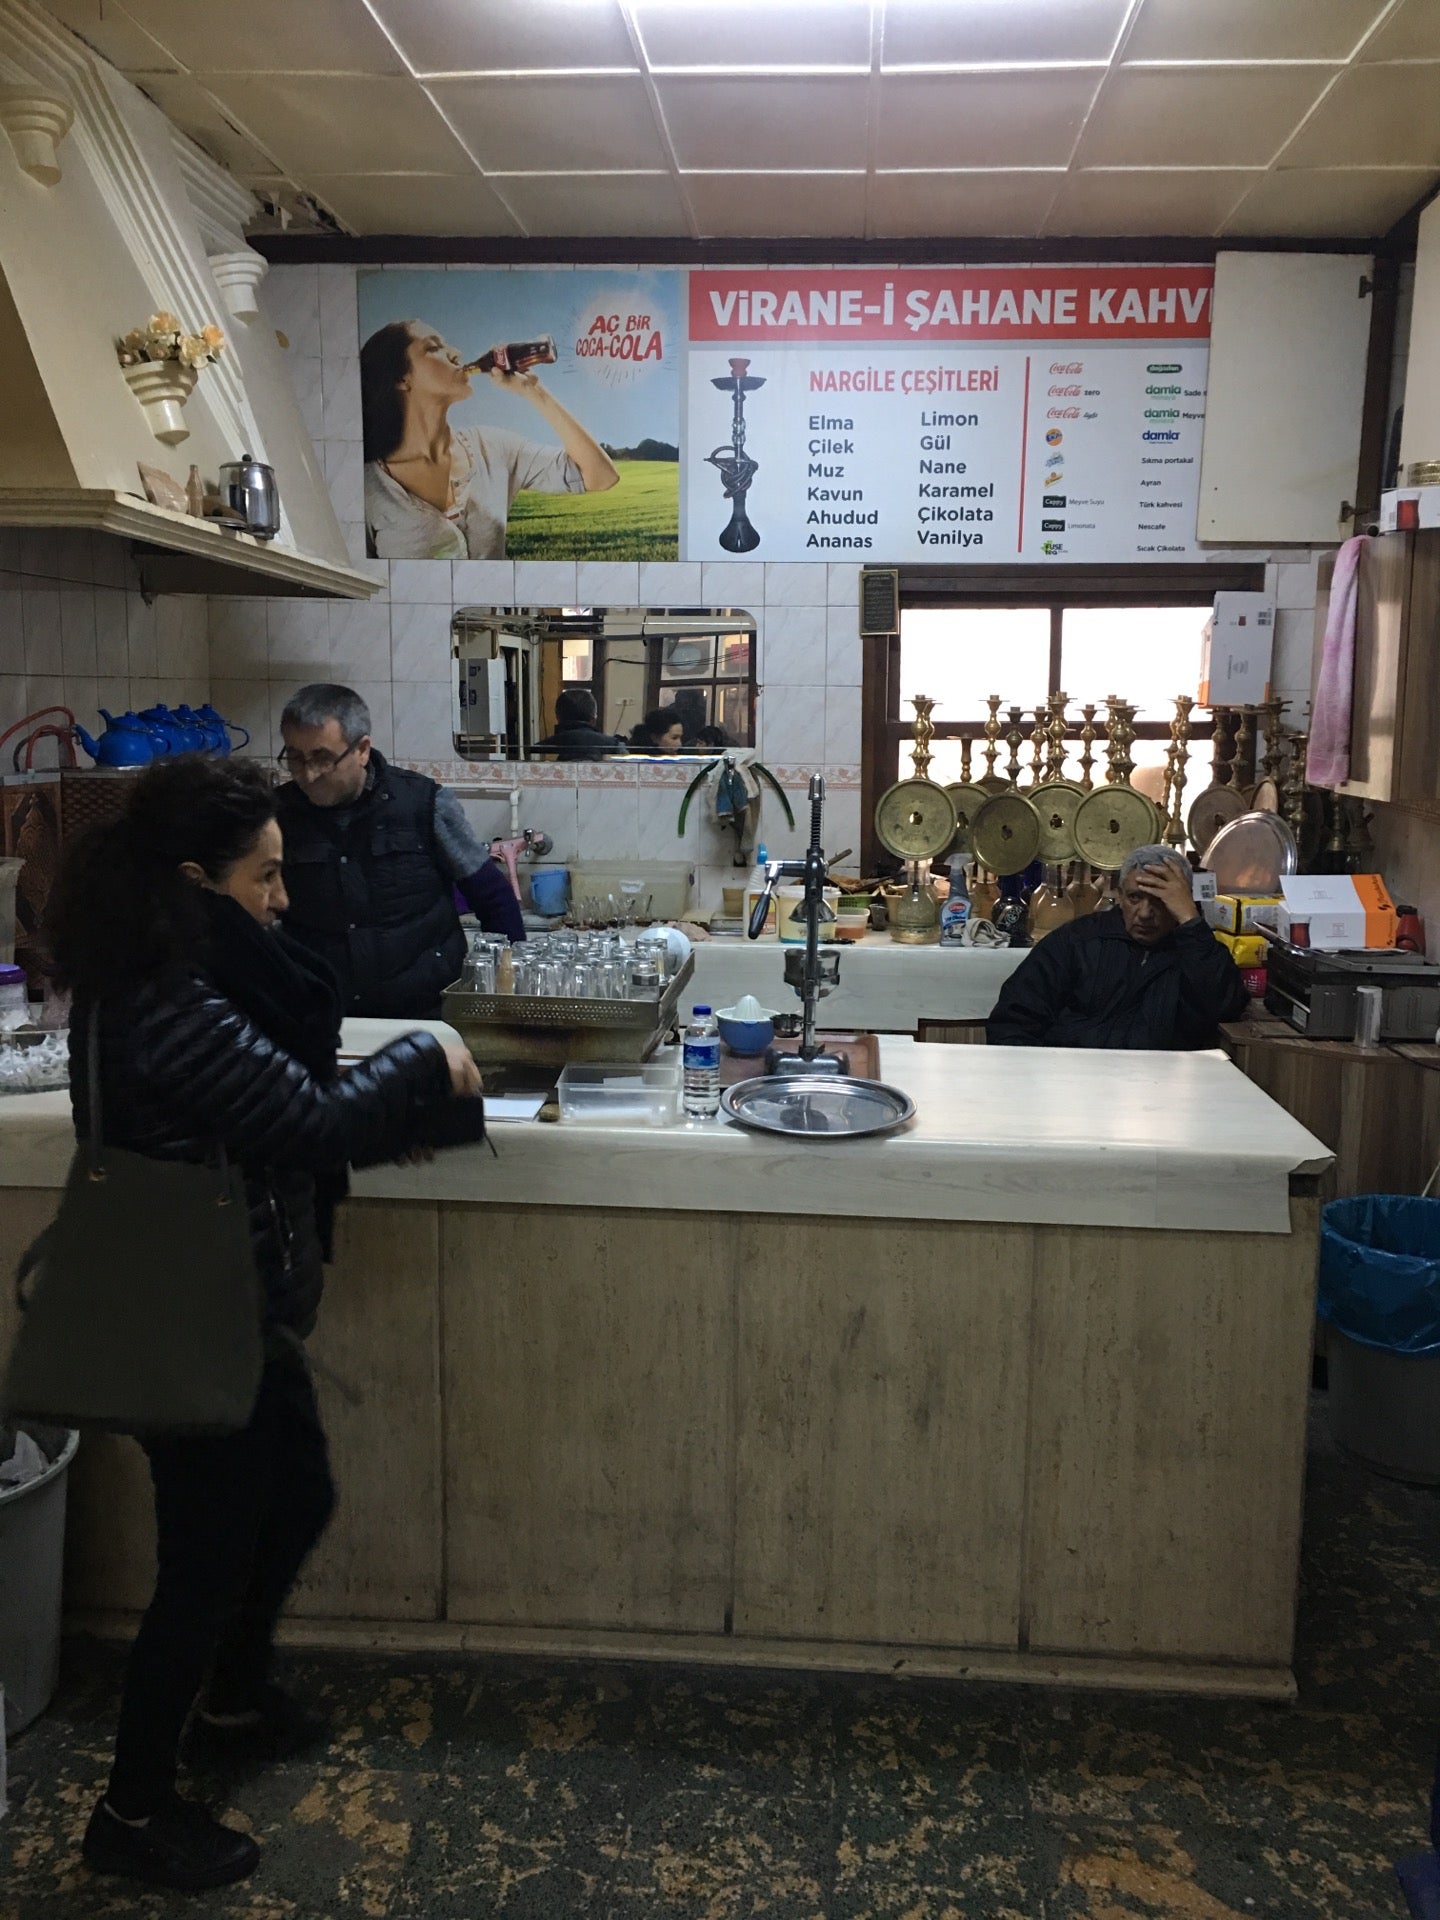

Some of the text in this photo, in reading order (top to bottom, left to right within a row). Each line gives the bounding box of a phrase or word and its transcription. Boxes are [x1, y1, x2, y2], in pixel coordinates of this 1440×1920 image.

[905, 290, 1077, 332] ŞAHANE
[1088, 288, 1212, 323] KAHV
[588, 314, 620, 336] AÇ
[576, 331, 662, 361] COCA-COLA
[810, 365, 1000, 394] NARGİLE ÇEŞİTLERİ
[809, 415, 854, 430] Elma
[922, 411, 979, 426] Limon
[809, 439, 854, 456] Çilek
[921, 435, 951, 450] Gül
[920, 460, 967, 474] Nane
[1164, 457, 1194, 465] portakal
[808, 464, 845, 477] Muz
[808, 487, 863, 501] Kavun
[919, 483, 994, 497] Karamel
[1044, 498, 1065, 506] Cappy
[807, 510, 879, 524] Ahudud
[918, 507, 994, 524] Çikolata
[1043, 522, 1064, 530] Cappy
[806, 534, 873, 548] Ananas
[917, 530, 984, 547] Vanilya
[1157, 545, 1186, 553] Çikolata
